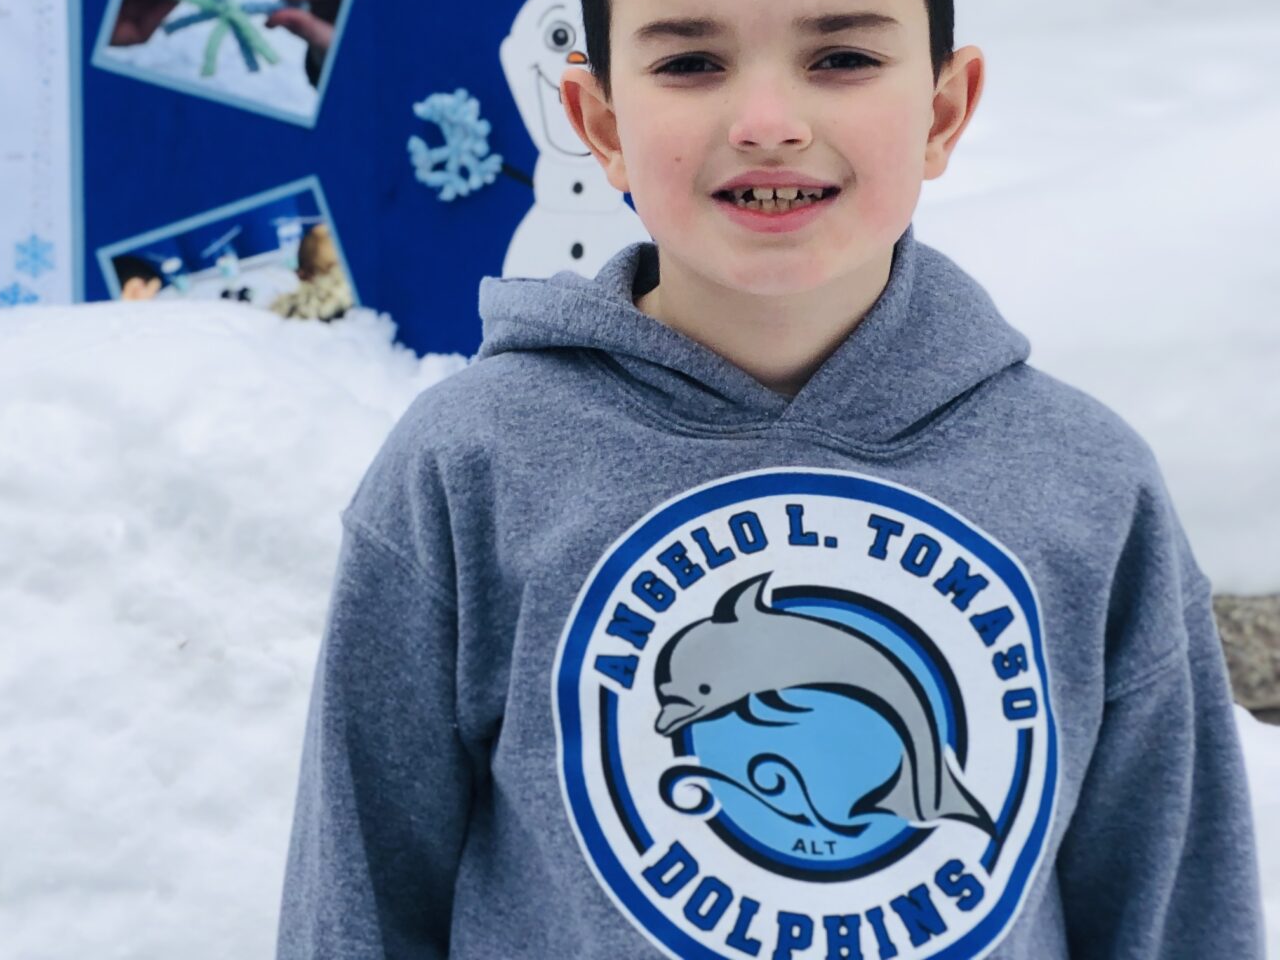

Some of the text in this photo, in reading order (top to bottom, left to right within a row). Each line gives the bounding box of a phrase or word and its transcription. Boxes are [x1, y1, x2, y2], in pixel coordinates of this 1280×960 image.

[593, 504, 1038, 722] ANGELO L. TOMASO
[641, 840, 986, 960] DOLPHINS
[791, 837, 838, 855] ALT
